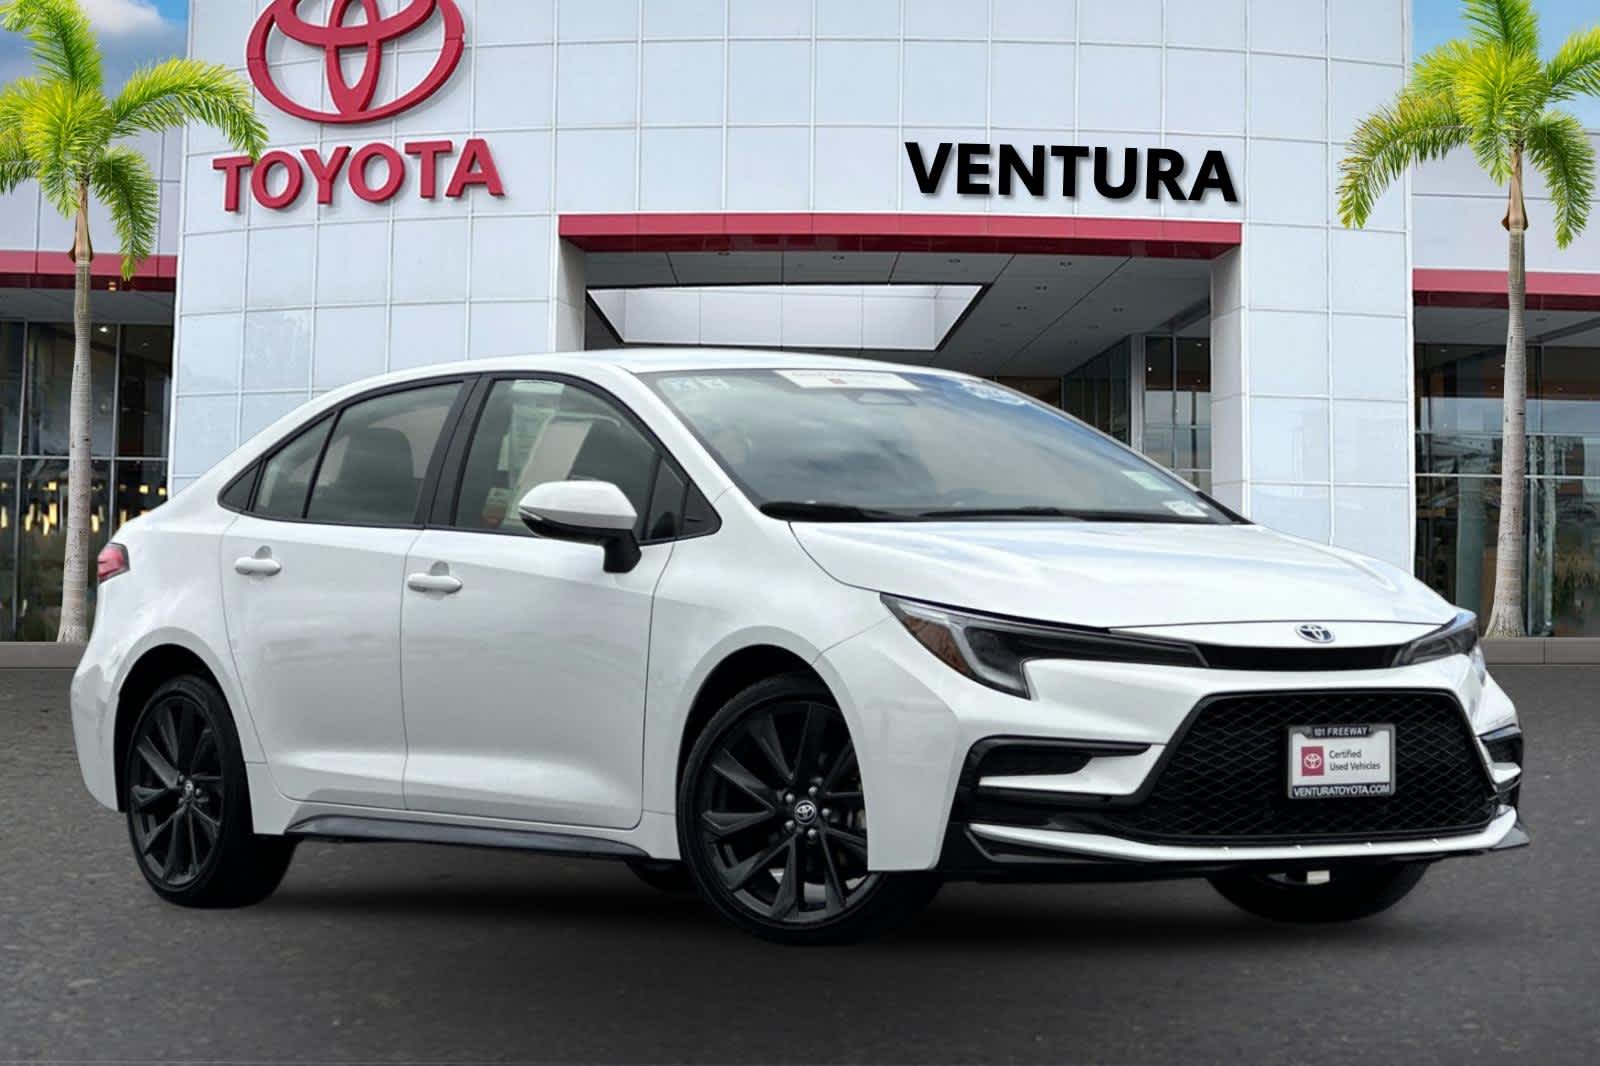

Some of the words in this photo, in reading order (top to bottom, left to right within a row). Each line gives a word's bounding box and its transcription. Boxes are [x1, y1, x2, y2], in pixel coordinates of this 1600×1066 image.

[213, 139, 505, 212] TOYOTA
[905, 142, 1238, 202] VENTURA
[1314, 728, 1326, 736] 101
[1327, 727, 1368, 736] FREEWAY
[1329, 750, 1362, 759] Certified
[1329, 763, 1348, 771] Used
[1350, 761, 1380, 770] Vehicles
[1293, 784, 1390, 797] VENTURATOYOTA.COM
